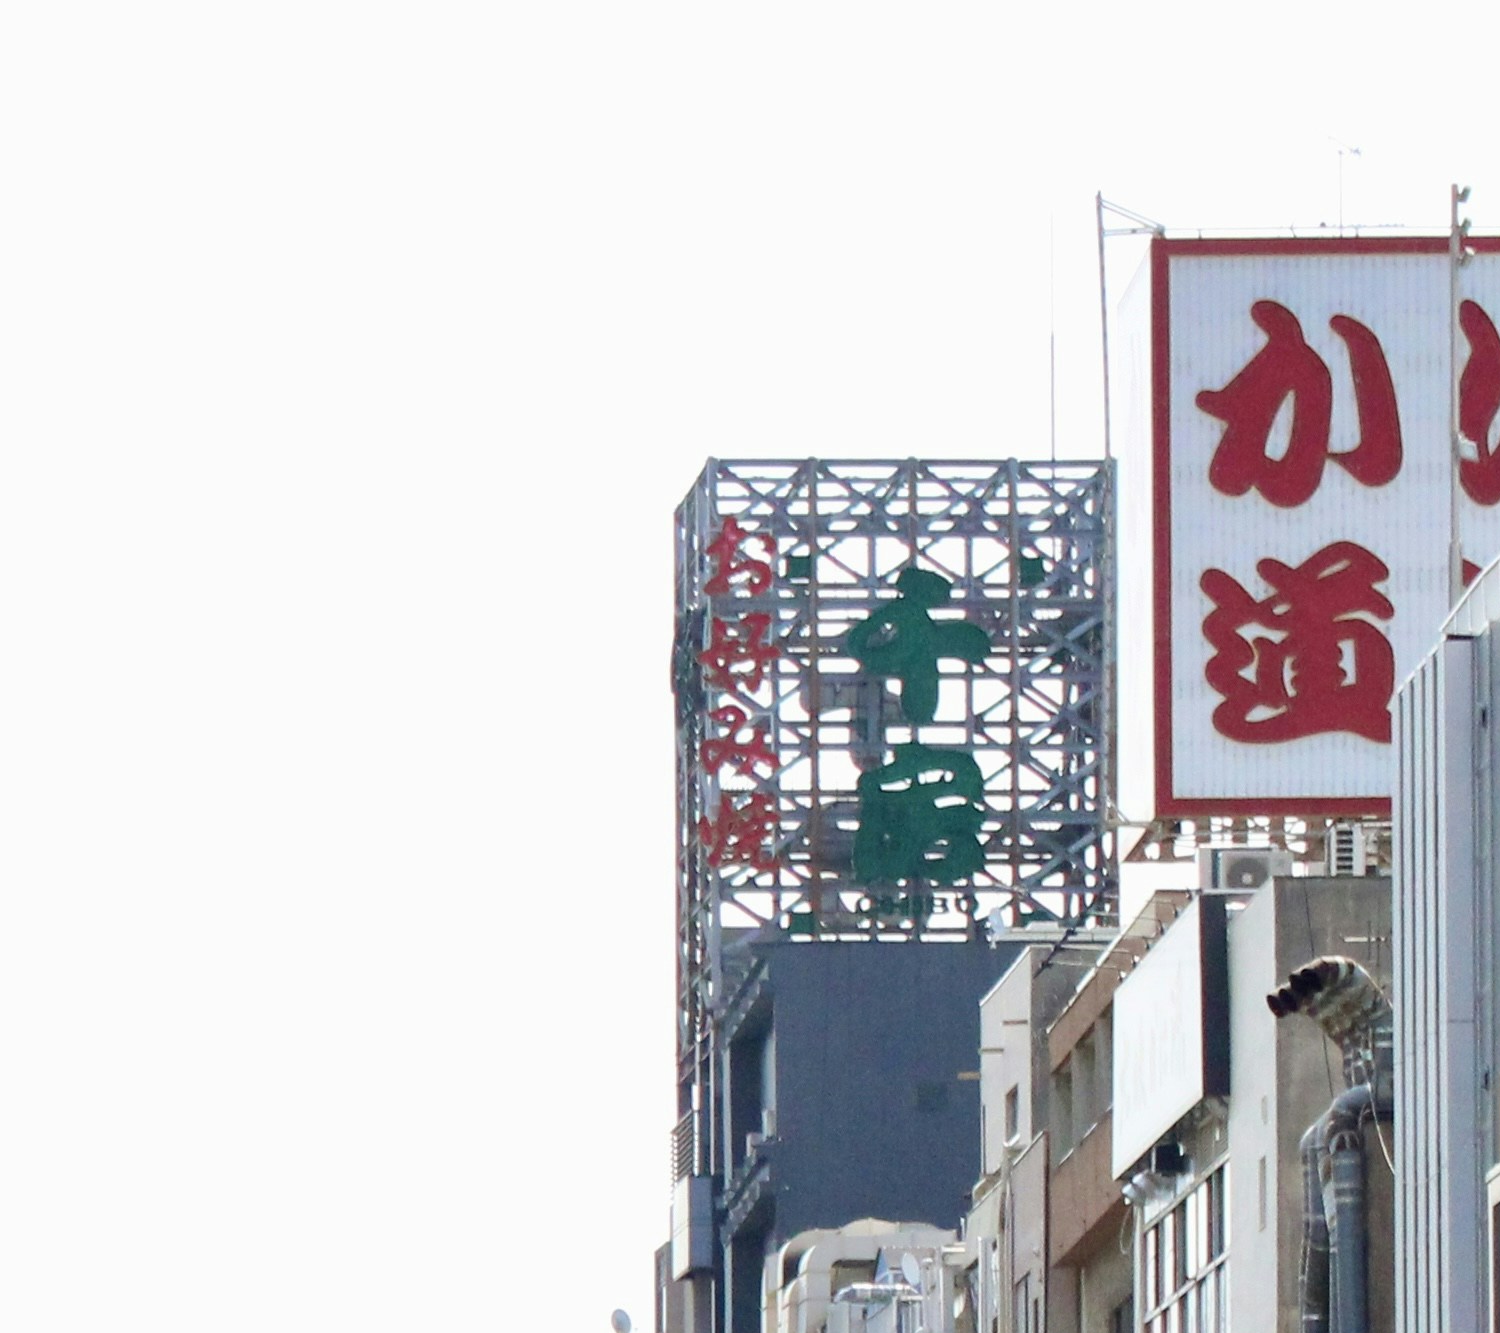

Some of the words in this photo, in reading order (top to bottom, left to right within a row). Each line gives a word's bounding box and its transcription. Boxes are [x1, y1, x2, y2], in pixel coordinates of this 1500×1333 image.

[700, 515, 781, 872] お好み焼
[846, 568, 990, 886] 千房
[851, 894, 980, 918] CHIBO
